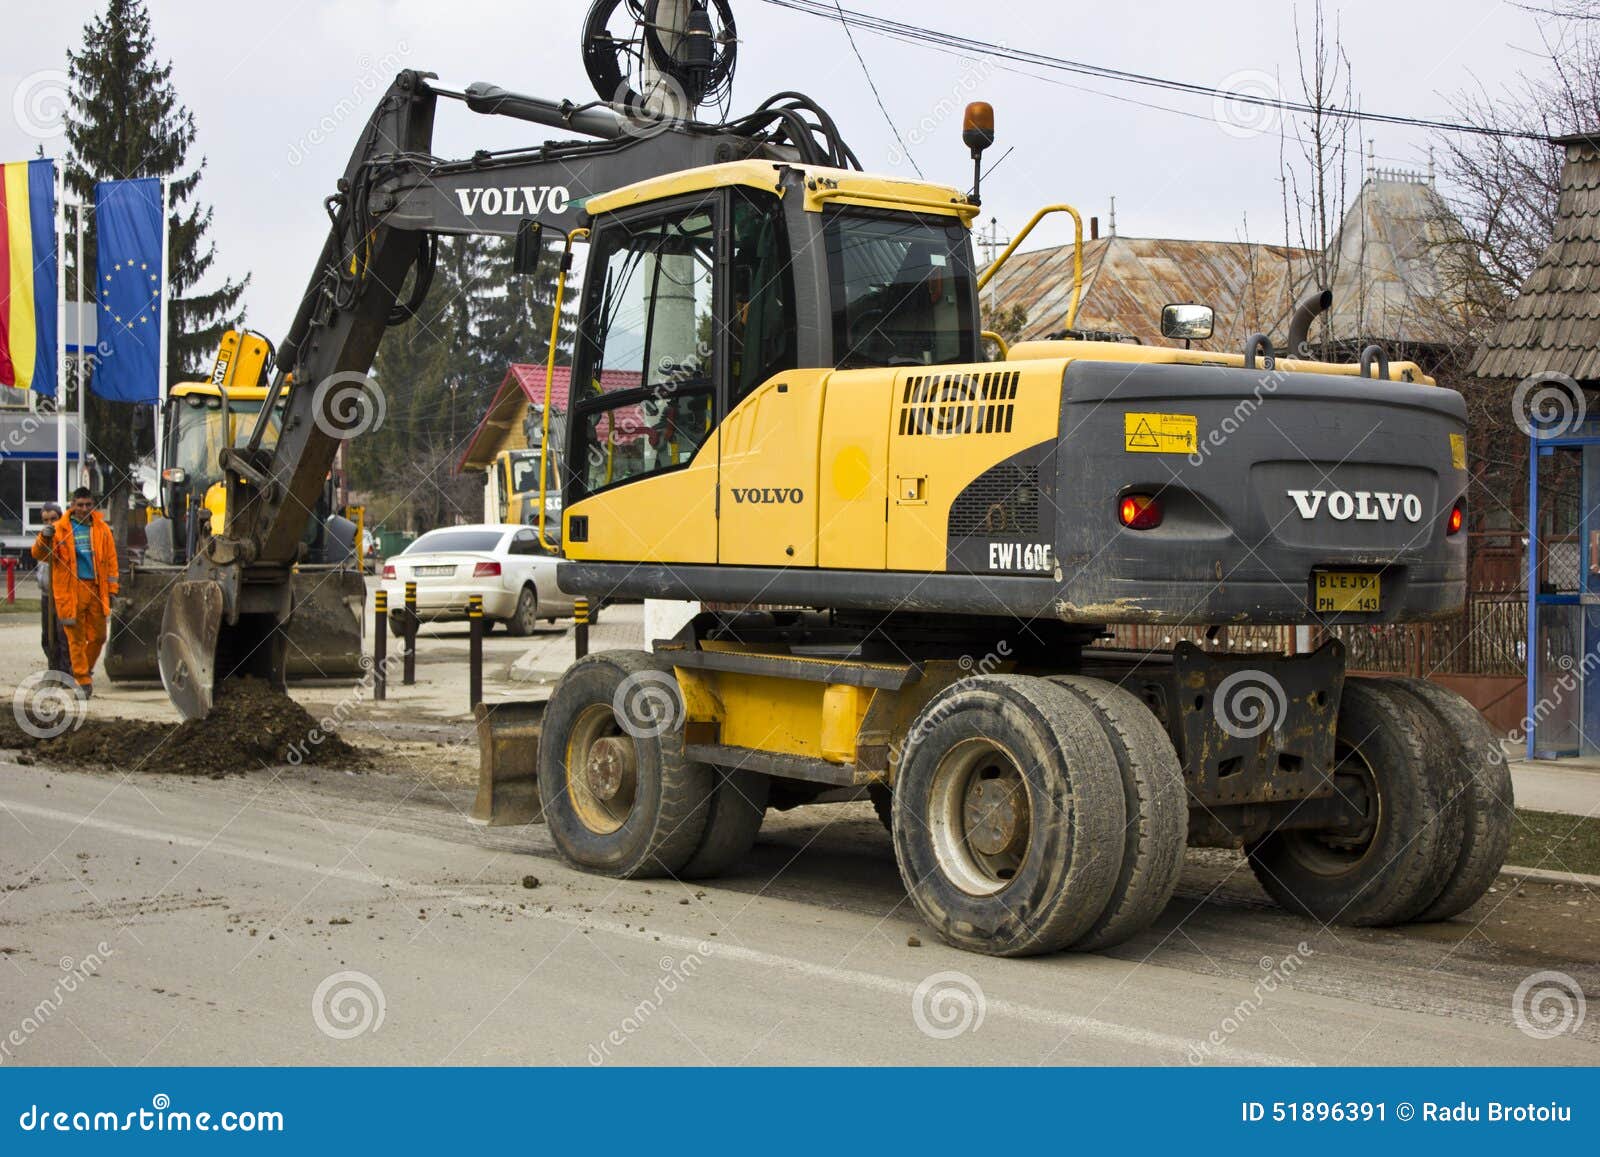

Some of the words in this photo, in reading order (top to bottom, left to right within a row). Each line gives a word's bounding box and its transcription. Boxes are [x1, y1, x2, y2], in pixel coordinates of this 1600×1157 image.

[455, 186, 570, 216] VOLVO
[731, 488, 804, 504] VOLVO
[1287, 490, 1422, 522] VOLVO
[1319, 598, 1334, 610] PH
[1357, 598, 1377, 610] 143
